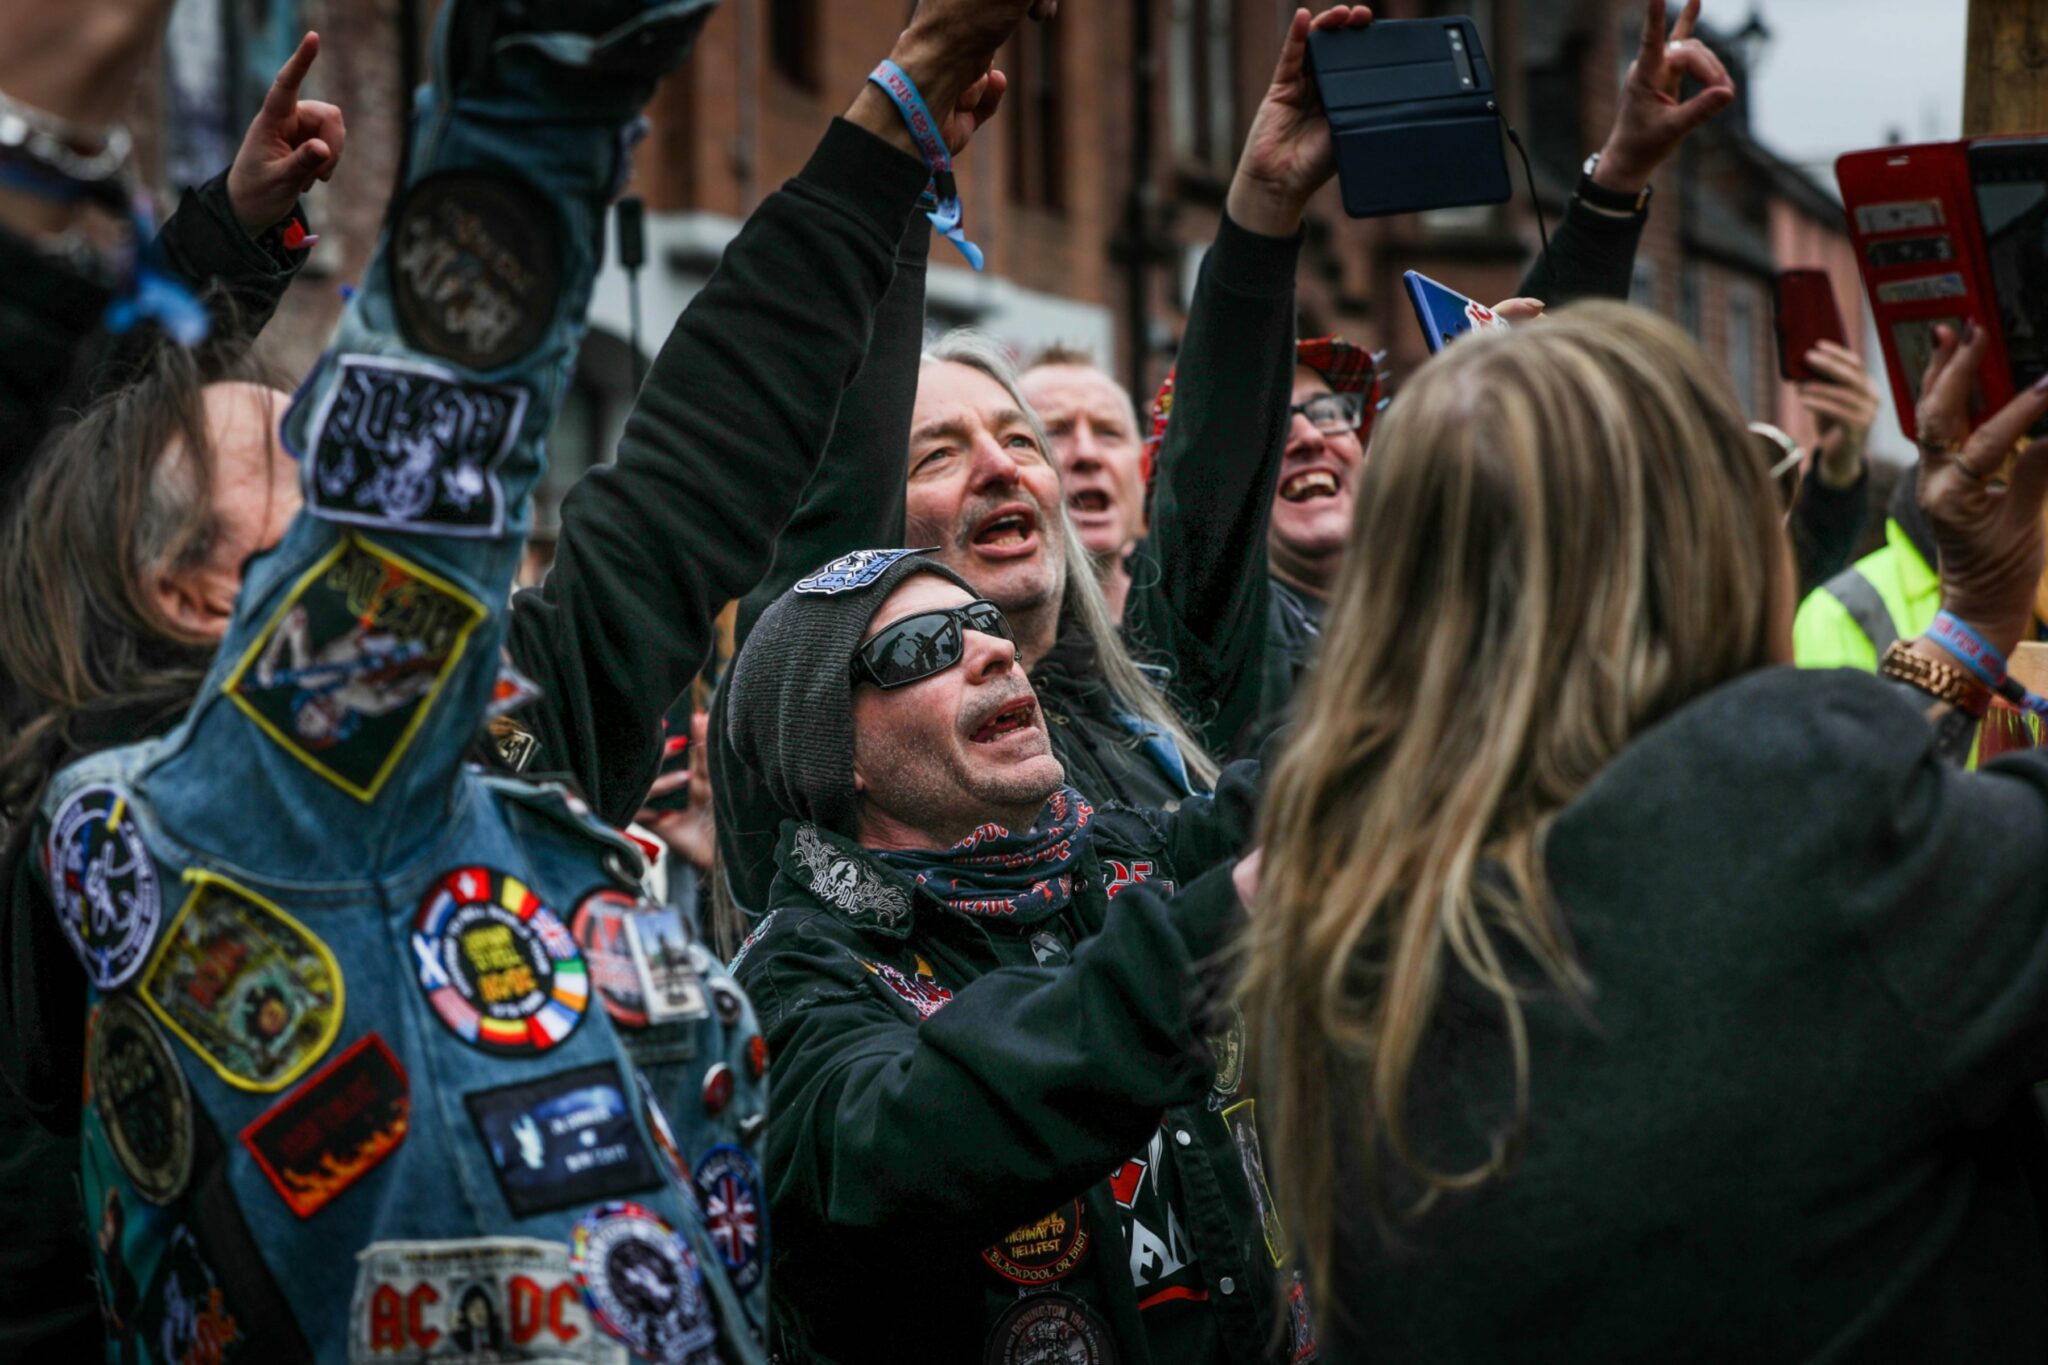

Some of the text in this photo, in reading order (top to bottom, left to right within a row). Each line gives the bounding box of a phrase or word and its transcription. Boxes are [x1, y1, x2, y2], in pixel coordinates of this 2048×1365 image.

[1049, 1223, 1065, 1237] TO
[990, 1230, 1088, 1280] BLACKPOOL OR BUST
[1011, 1239, 1061, 1259] HELLFEST
[1011, 1304, 1067, 1336] DONINGTON
